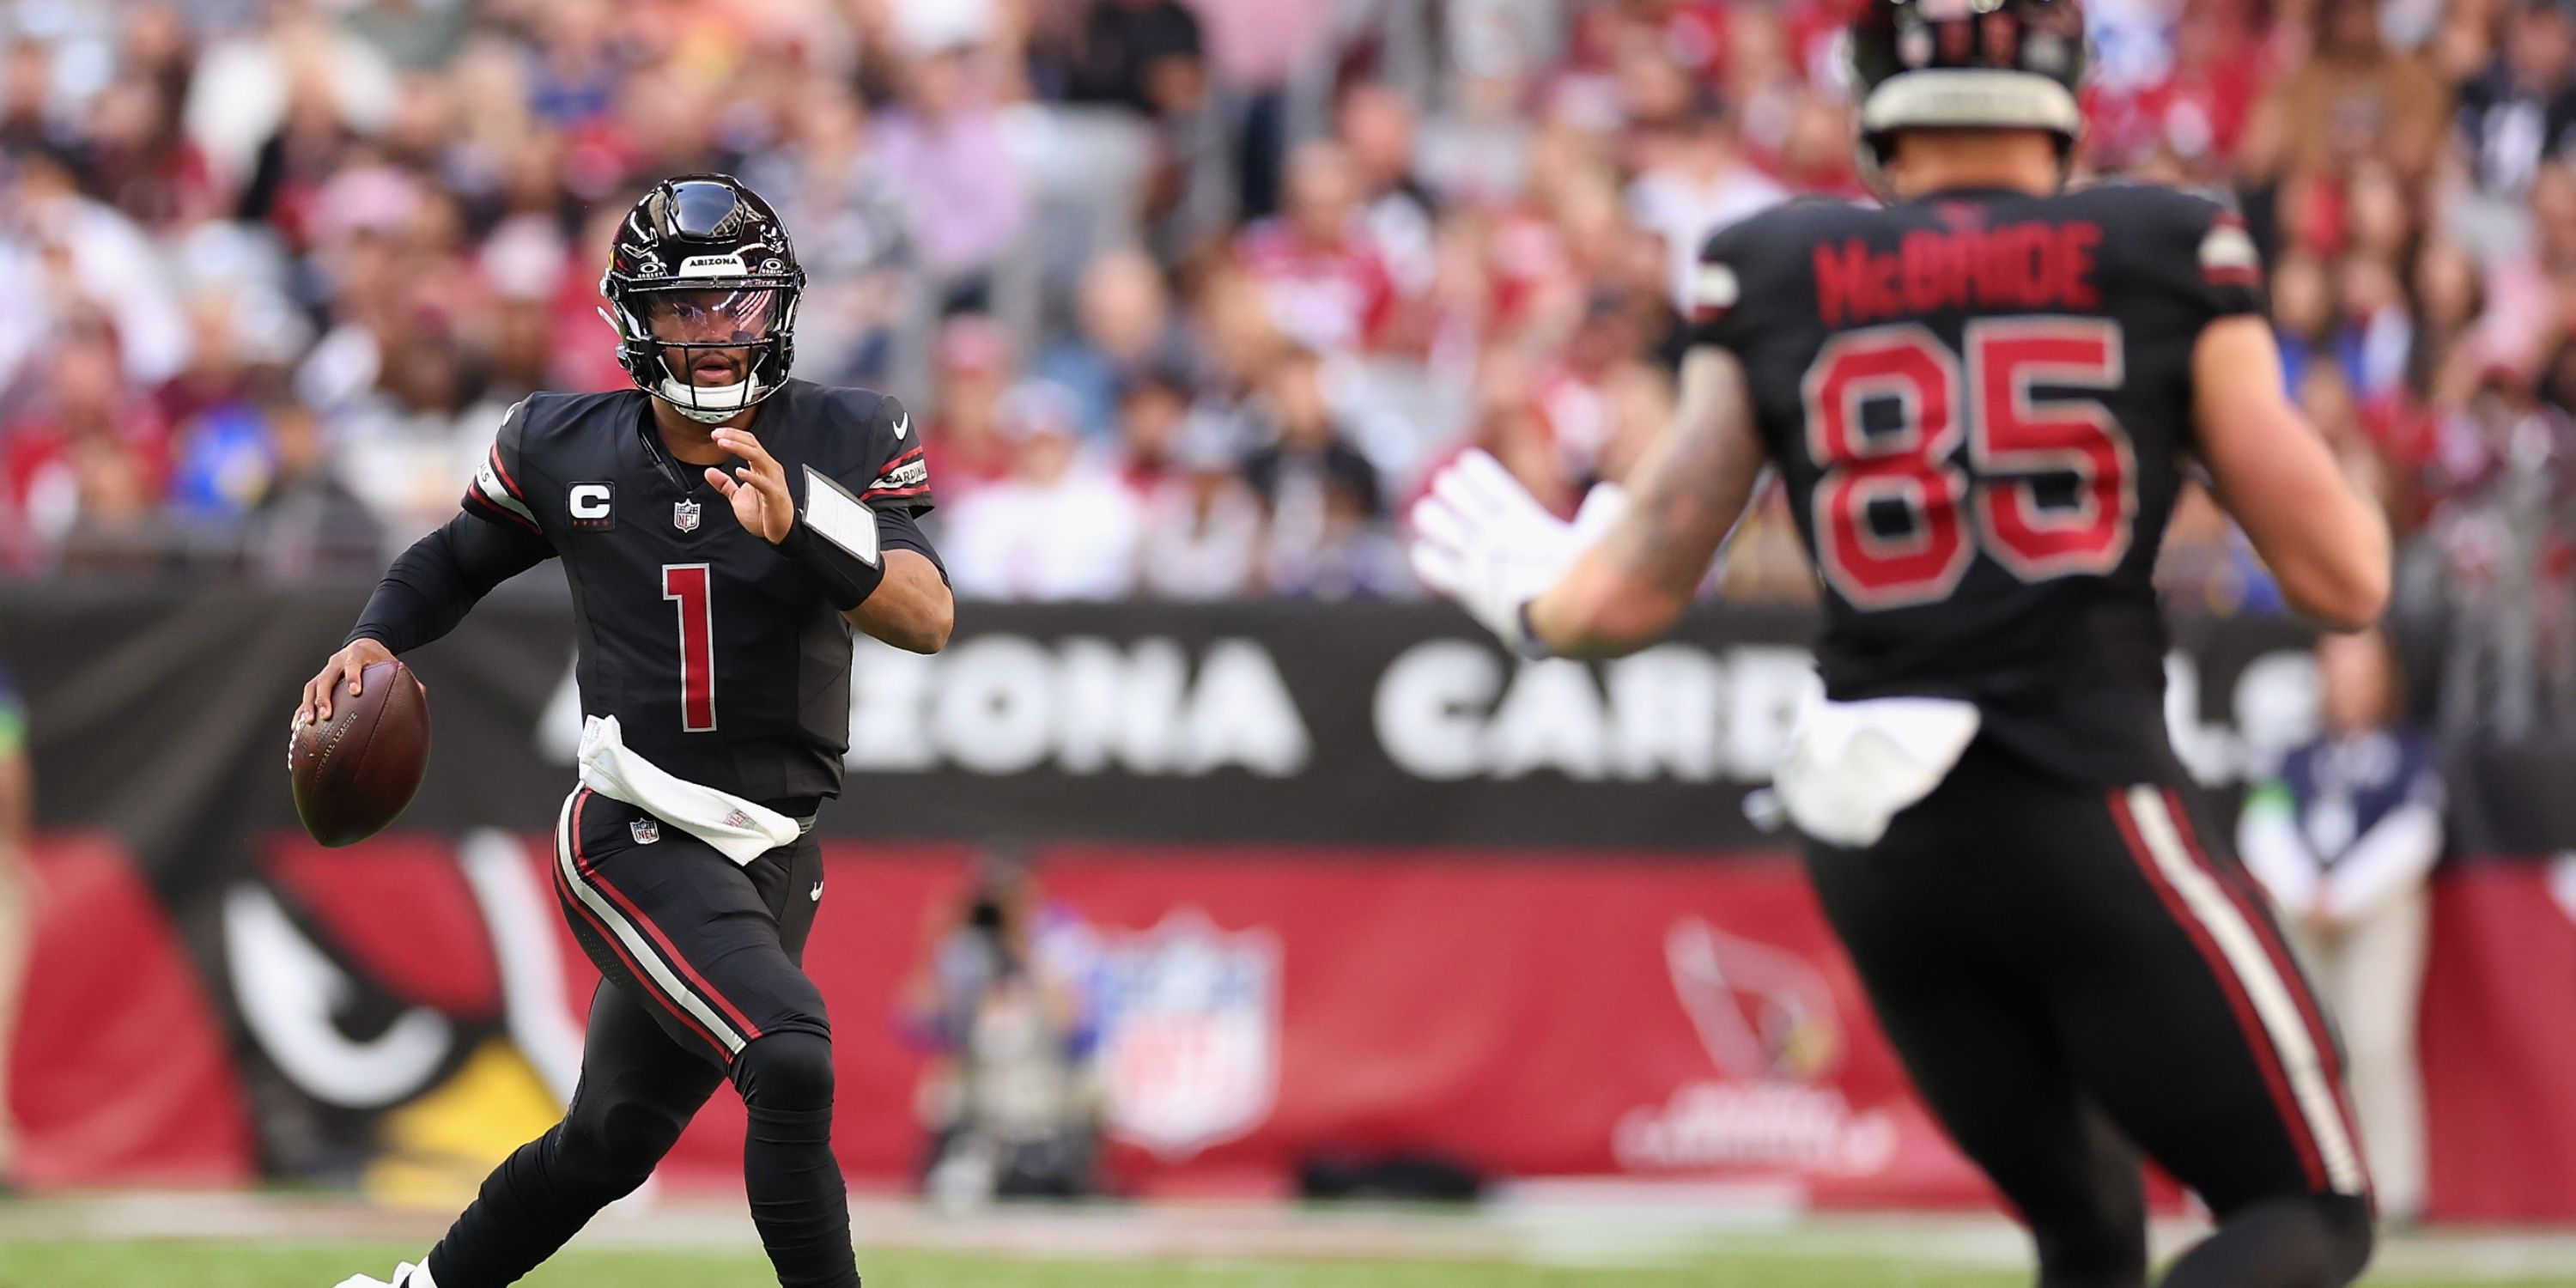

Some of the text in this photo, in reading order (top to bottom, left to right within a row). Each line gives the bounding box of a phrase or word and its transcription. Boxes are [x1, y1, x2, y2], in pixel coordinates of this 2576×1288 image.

[690, 258, 738, 267] ARIZONA
[570, 485, 610, 519] C
[1801, 314, 2138, 611] 85
[662, 562, 716, 732] 1
